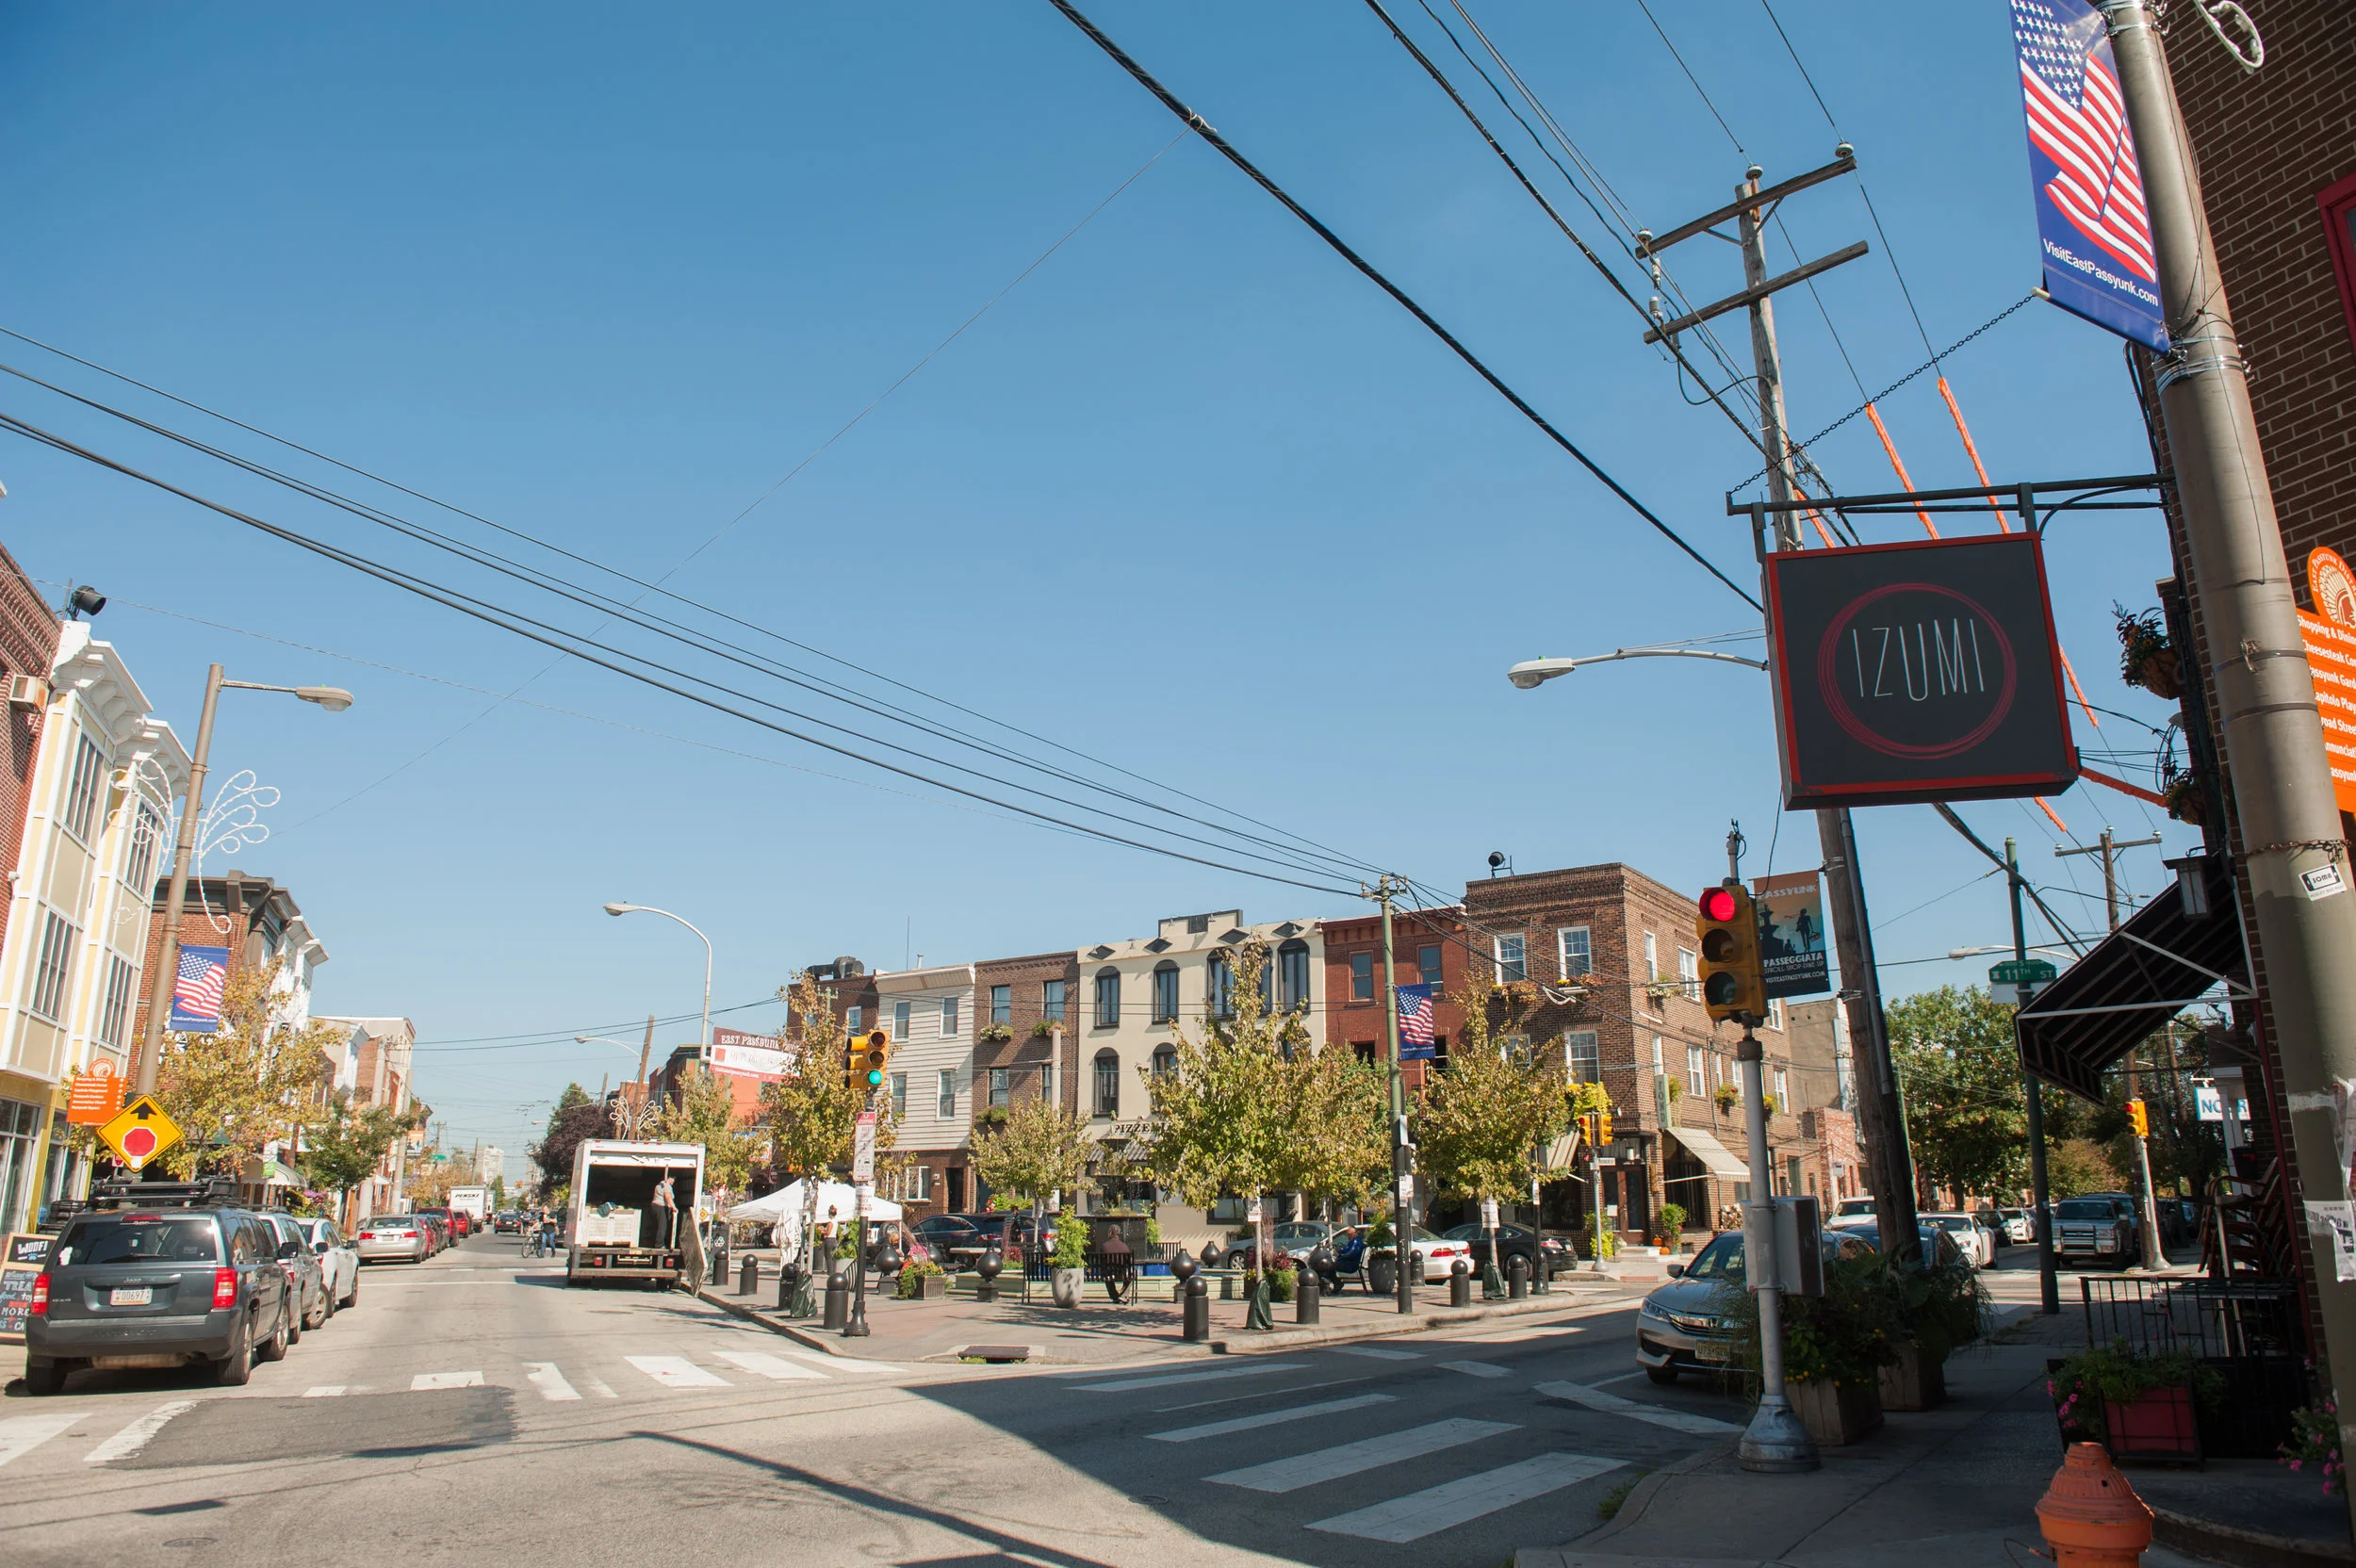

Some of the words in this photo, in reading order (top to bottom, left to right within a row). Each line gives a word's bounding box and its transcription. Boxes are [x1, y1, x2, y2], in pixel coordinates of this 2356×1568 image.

[2042, 237, 2159, 307] VisitEastPassyunk.com
[2297, 614, 2331, 639] Shopping
[2331, 627, 2338, 639] &
[1852, 617, 1985, 702] IZUMI
[2315, 691, 2341, 708] apitolo
[2320, 716, 2337, 730] road
[1763, 952, 1824, 968] PASSEGGIATA
[2004, 968, 2032, 980] 11TH
[2039, 970, 2053, 979] ST
[721, 1035, 741, 1045] EAST
[2201, 1099, 2248, 1114] NOR
[4, 1281, 35, 1292] TREA
